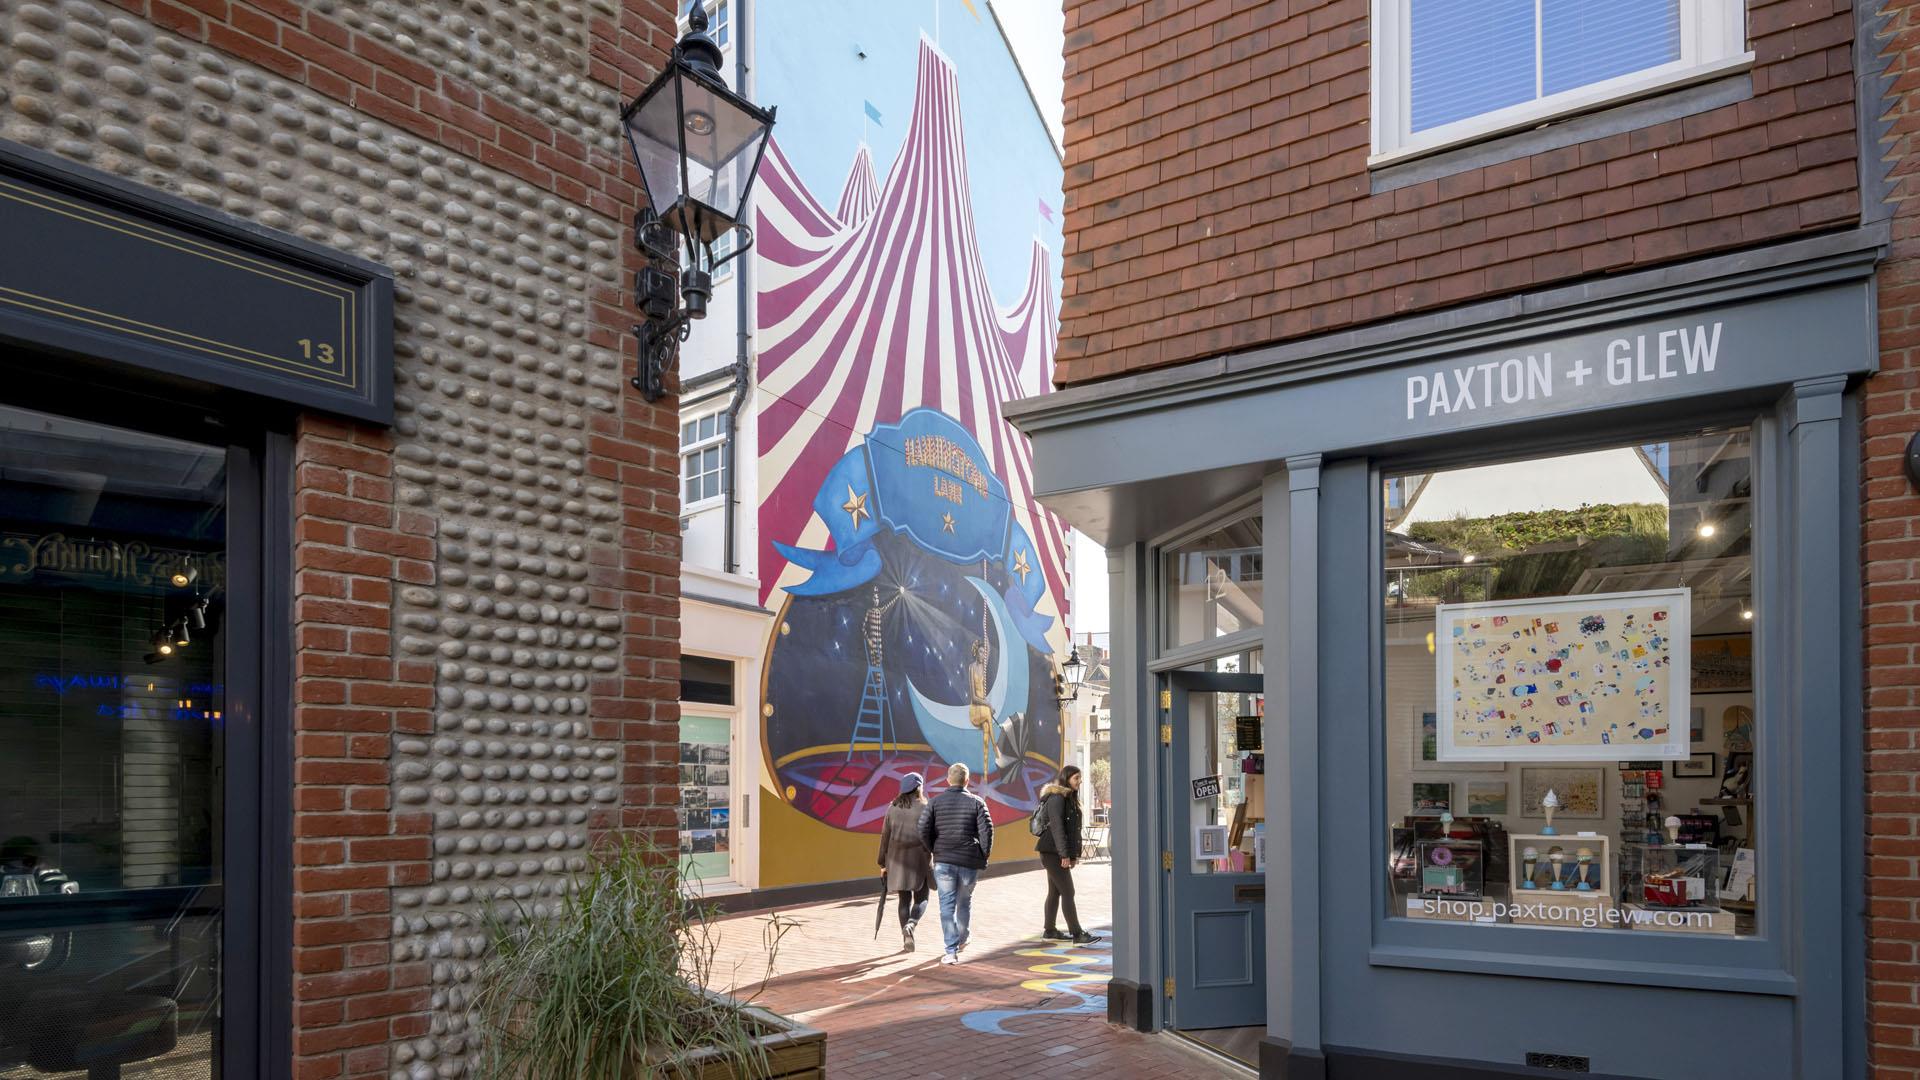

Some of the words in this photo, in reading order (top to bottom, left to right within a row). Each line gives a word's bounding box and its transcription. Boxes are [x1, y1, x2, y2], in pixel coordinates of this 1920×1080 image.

[297, 338, 336, 365] 13
[1407, 352, 1553, 420] PAXTON
[1606, 322, 1723, 386] GLEW
[1196, 784, 1218, 797] OPEN
[1424, 895, 1713, 930] shop.paxtonglew.com
